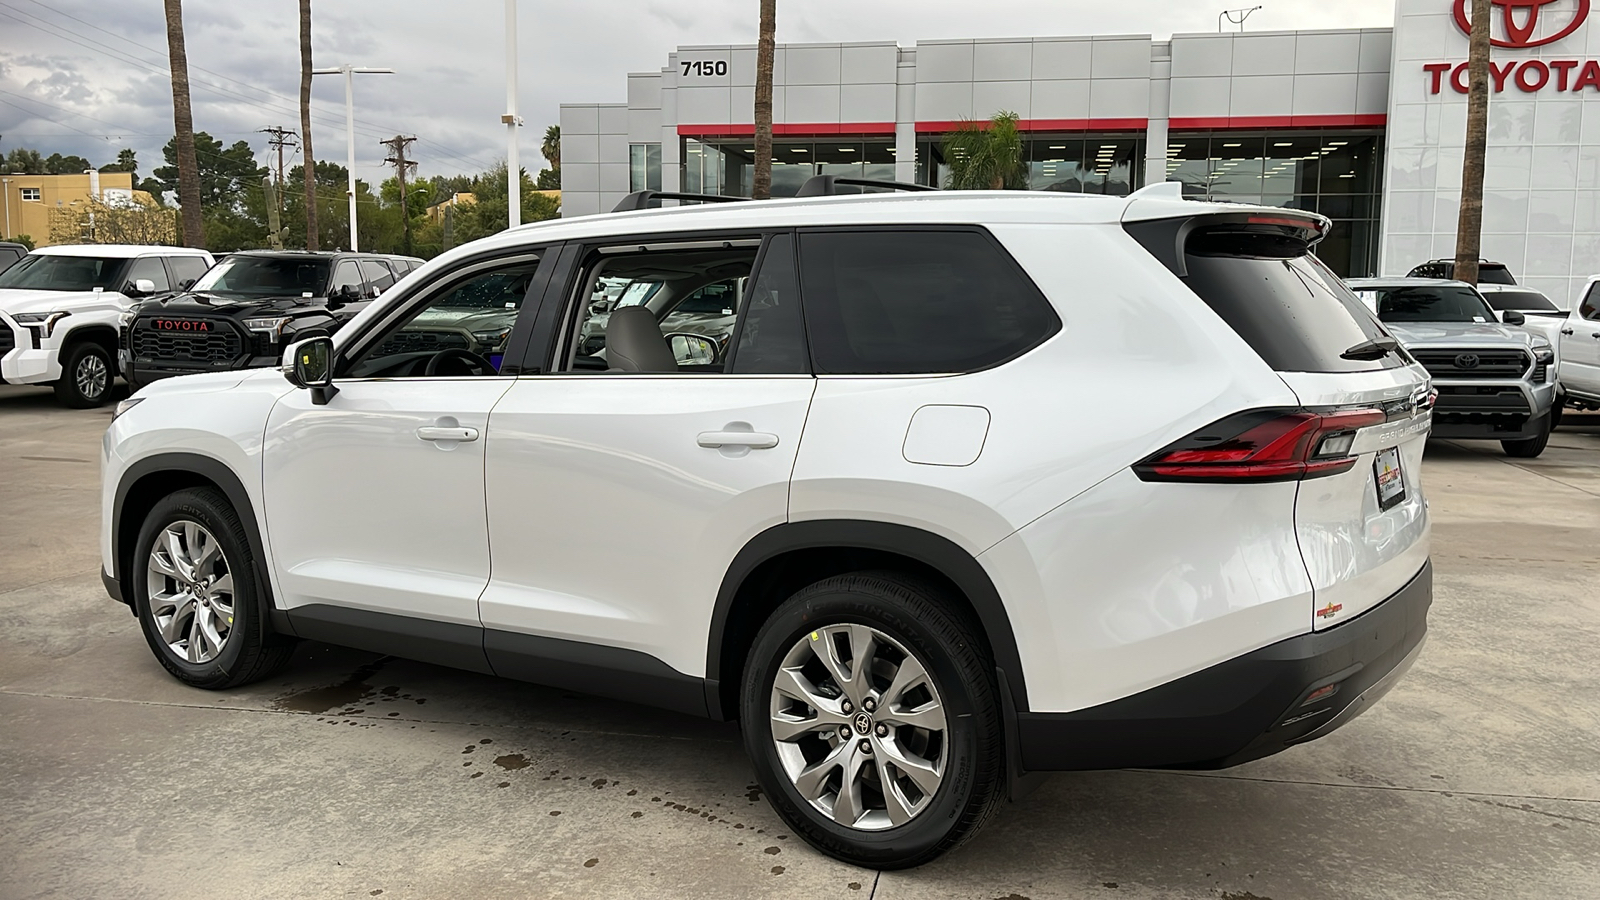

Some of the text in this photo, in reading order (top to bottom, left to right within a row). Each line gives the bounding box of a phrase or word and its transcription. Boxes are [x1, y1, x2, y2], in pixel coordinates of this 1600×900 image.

[680, 60, 728, 77] 7150
[1423, 59, 1600, 95] TOYOTA
[156, 319, 209, 331] TOYOTA
